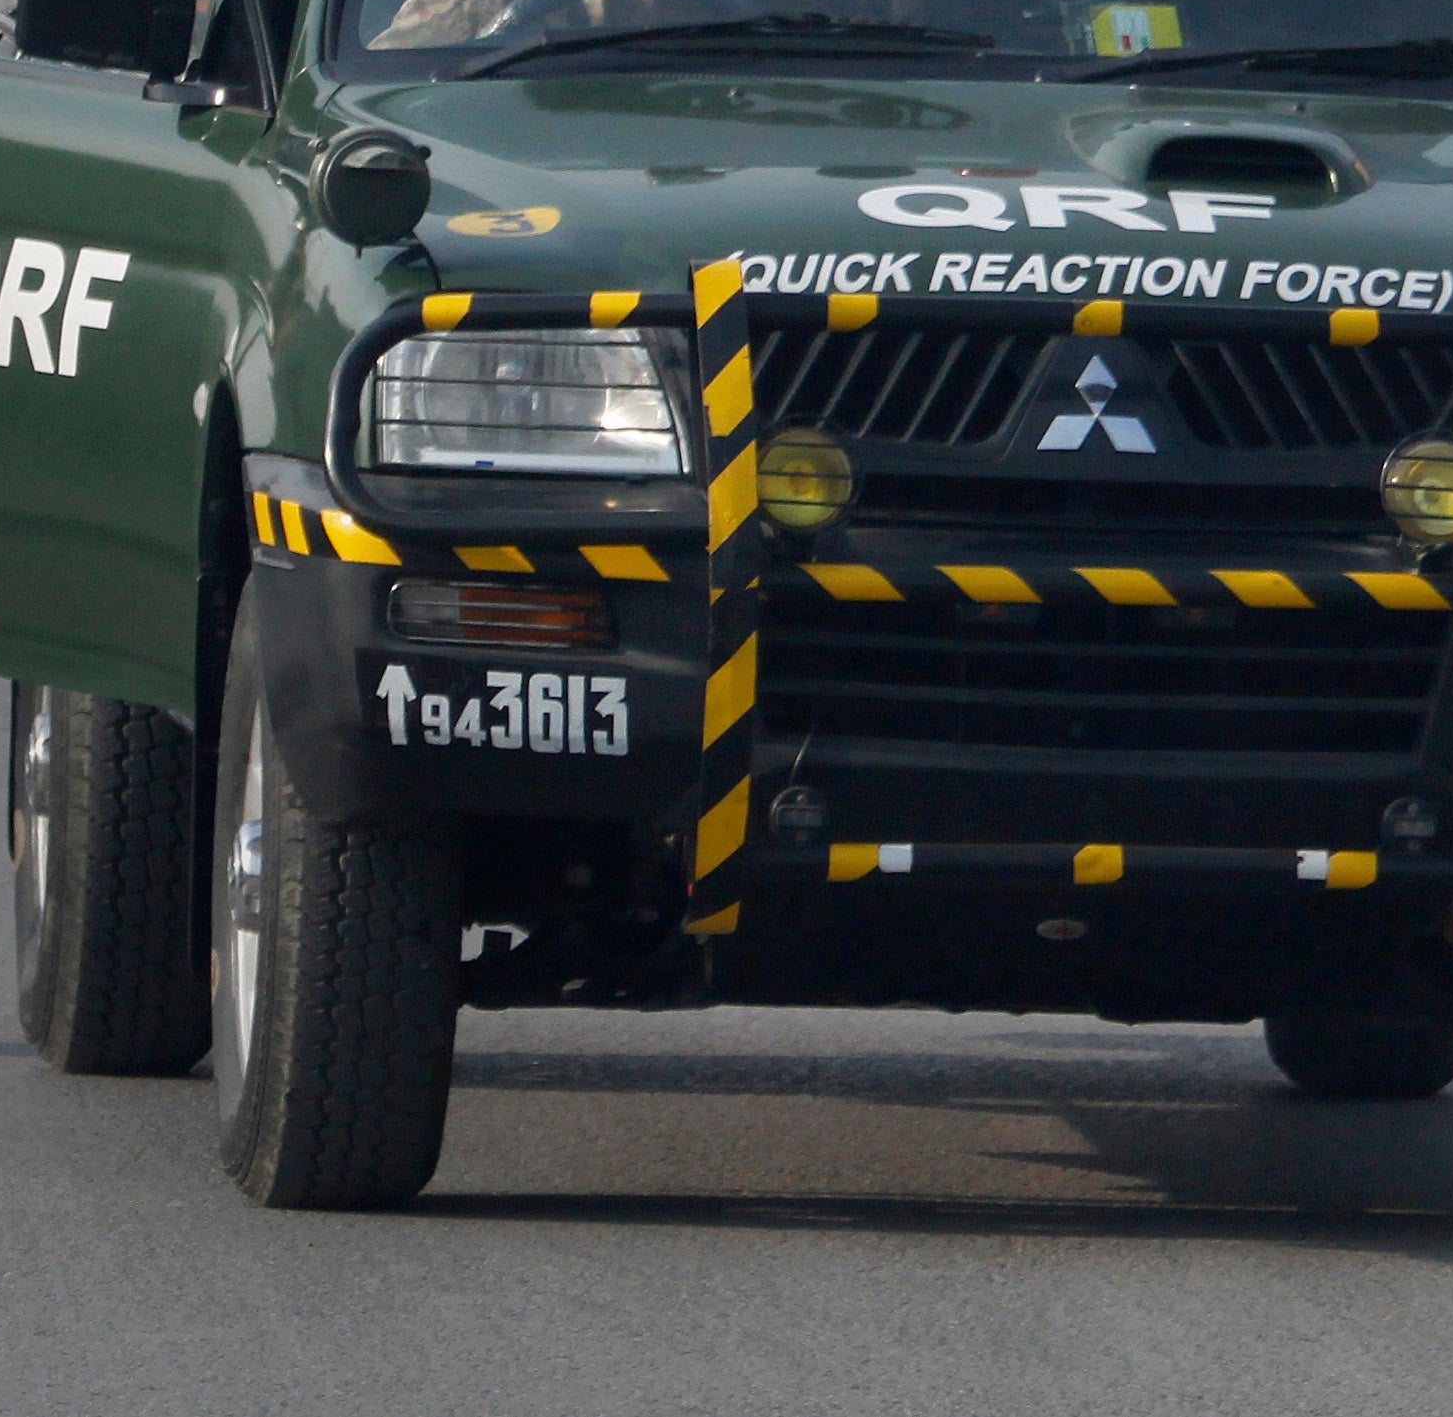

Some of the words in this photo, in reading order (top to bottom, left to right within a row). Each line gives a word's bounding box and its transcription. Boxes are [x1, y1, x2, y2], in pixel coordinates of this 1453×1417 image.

[856, 184, 1276, 232] QRF
[727, 250, 921, 294] QUICK
[928, 252, 1228, 299] REACTION
